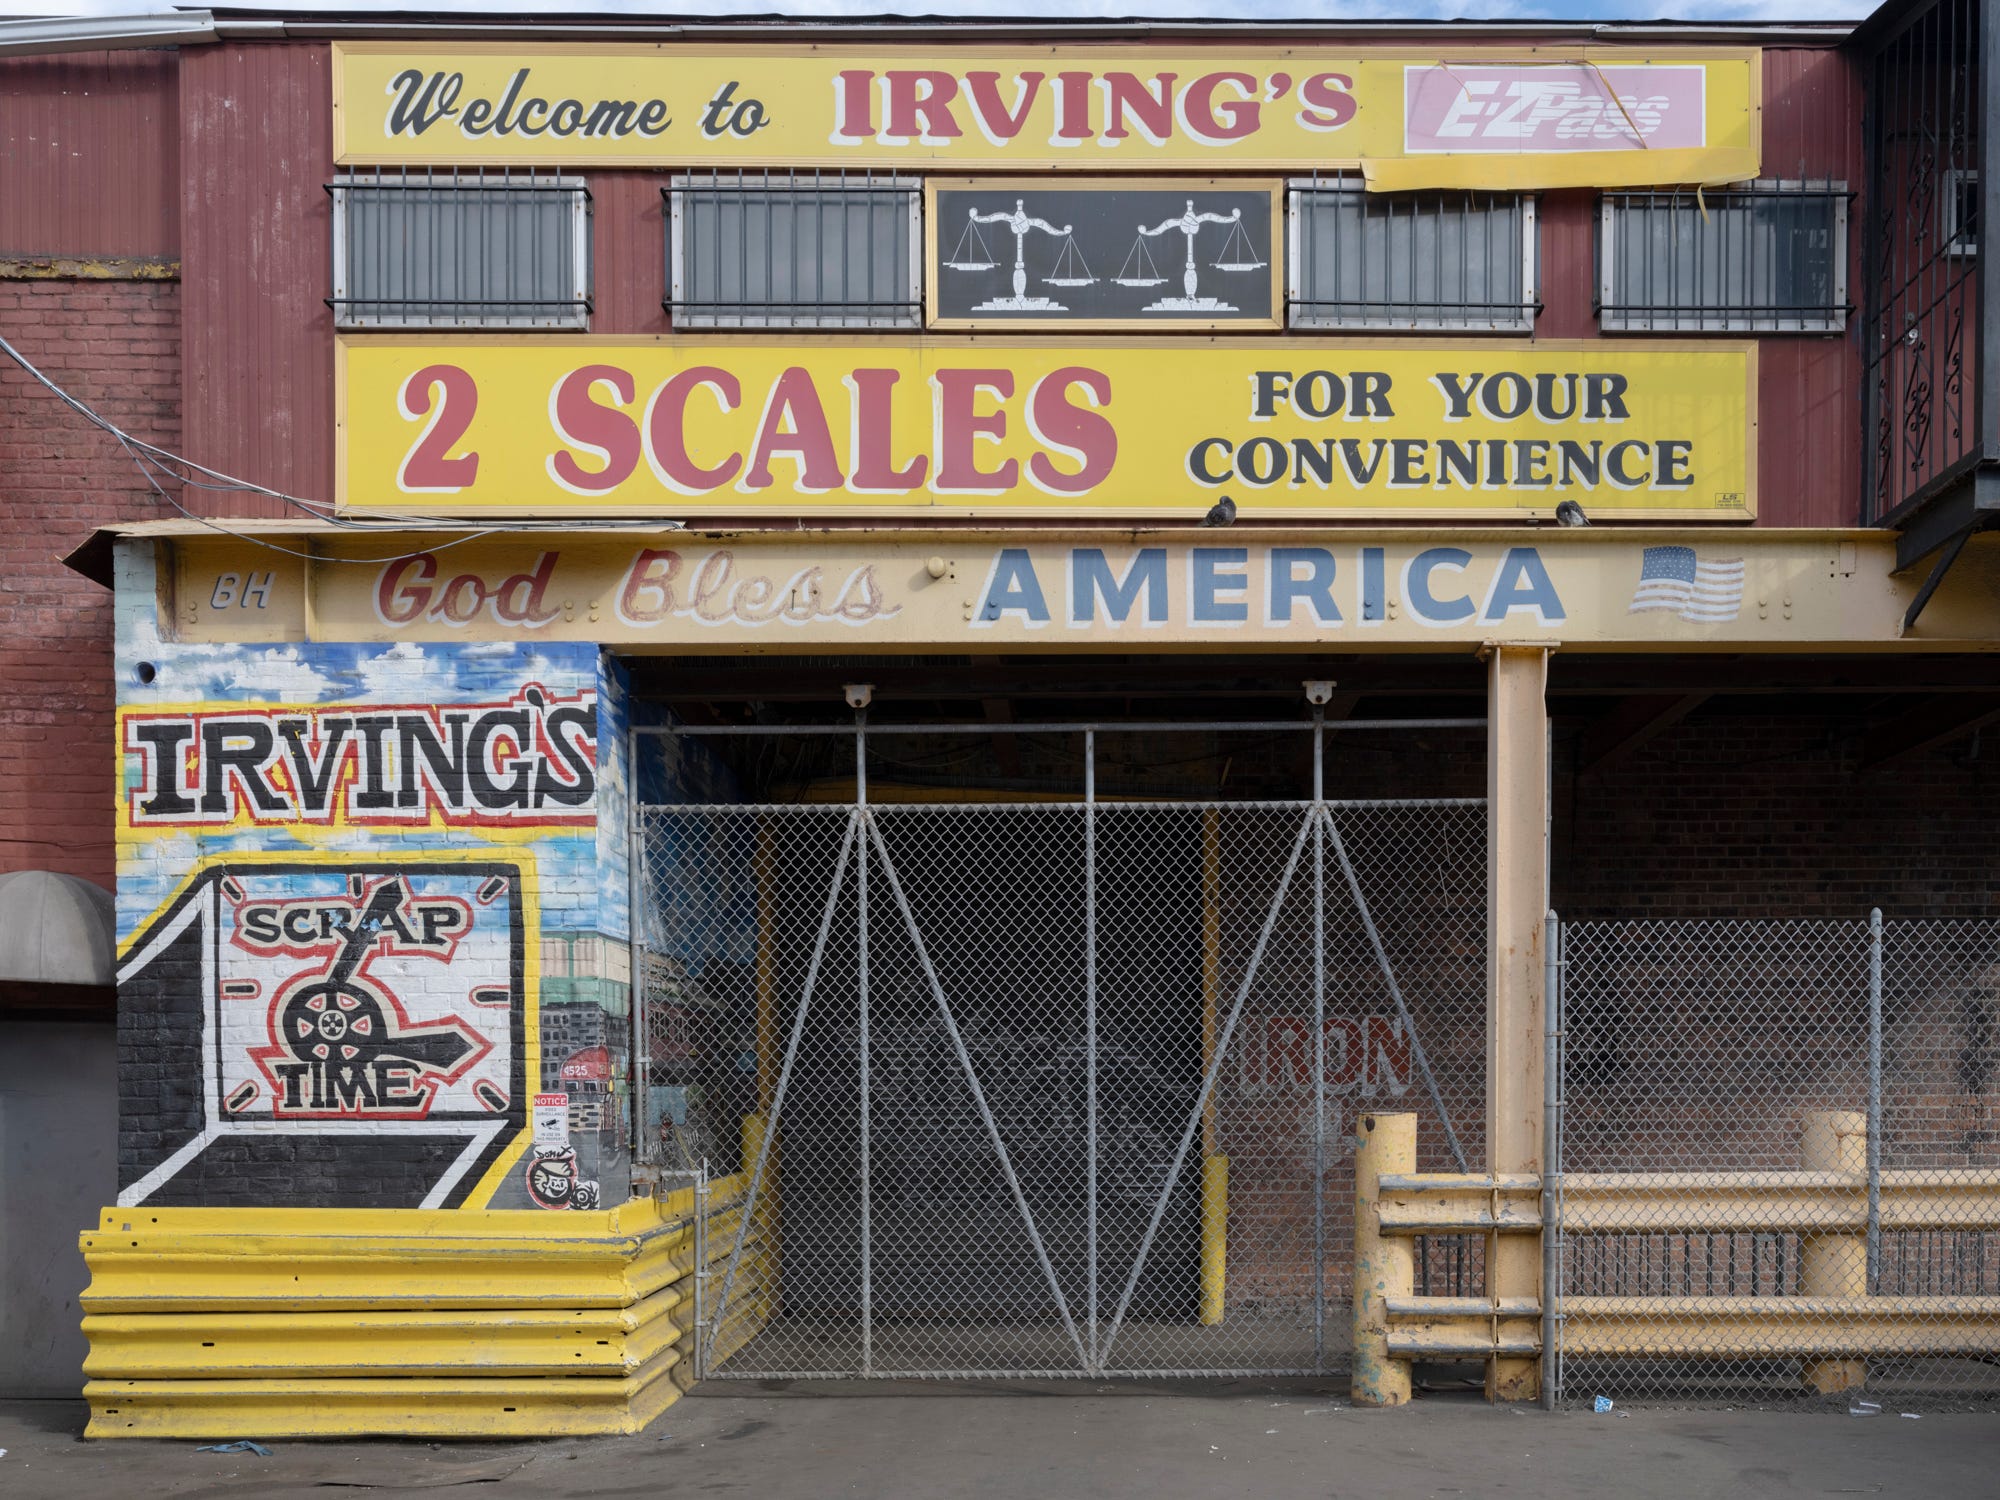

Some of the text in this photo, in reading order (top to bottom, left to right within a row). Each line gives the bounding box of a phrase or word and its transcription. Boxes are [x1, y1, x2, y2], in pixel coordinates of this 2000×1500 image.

[385, 68, 1357, 147] Welcome to IRVING'S
[1248, 371, 1631, 424] FOR YOUR
[397, 364, 1118, 497] 2 SCALES
[1185, 437, 1695, 491] CONVENIENCE
[210, 571, 276, 609] BH
[372, 546, 1568, 630] God Bless AMERICA
[136, 690, 597, 815] IRVING'S
[244, 880, 461, 946] SCRAP
[274, 1062, 422, 1108] TIME
[534, 1097, 567, 1105] NOTICE
